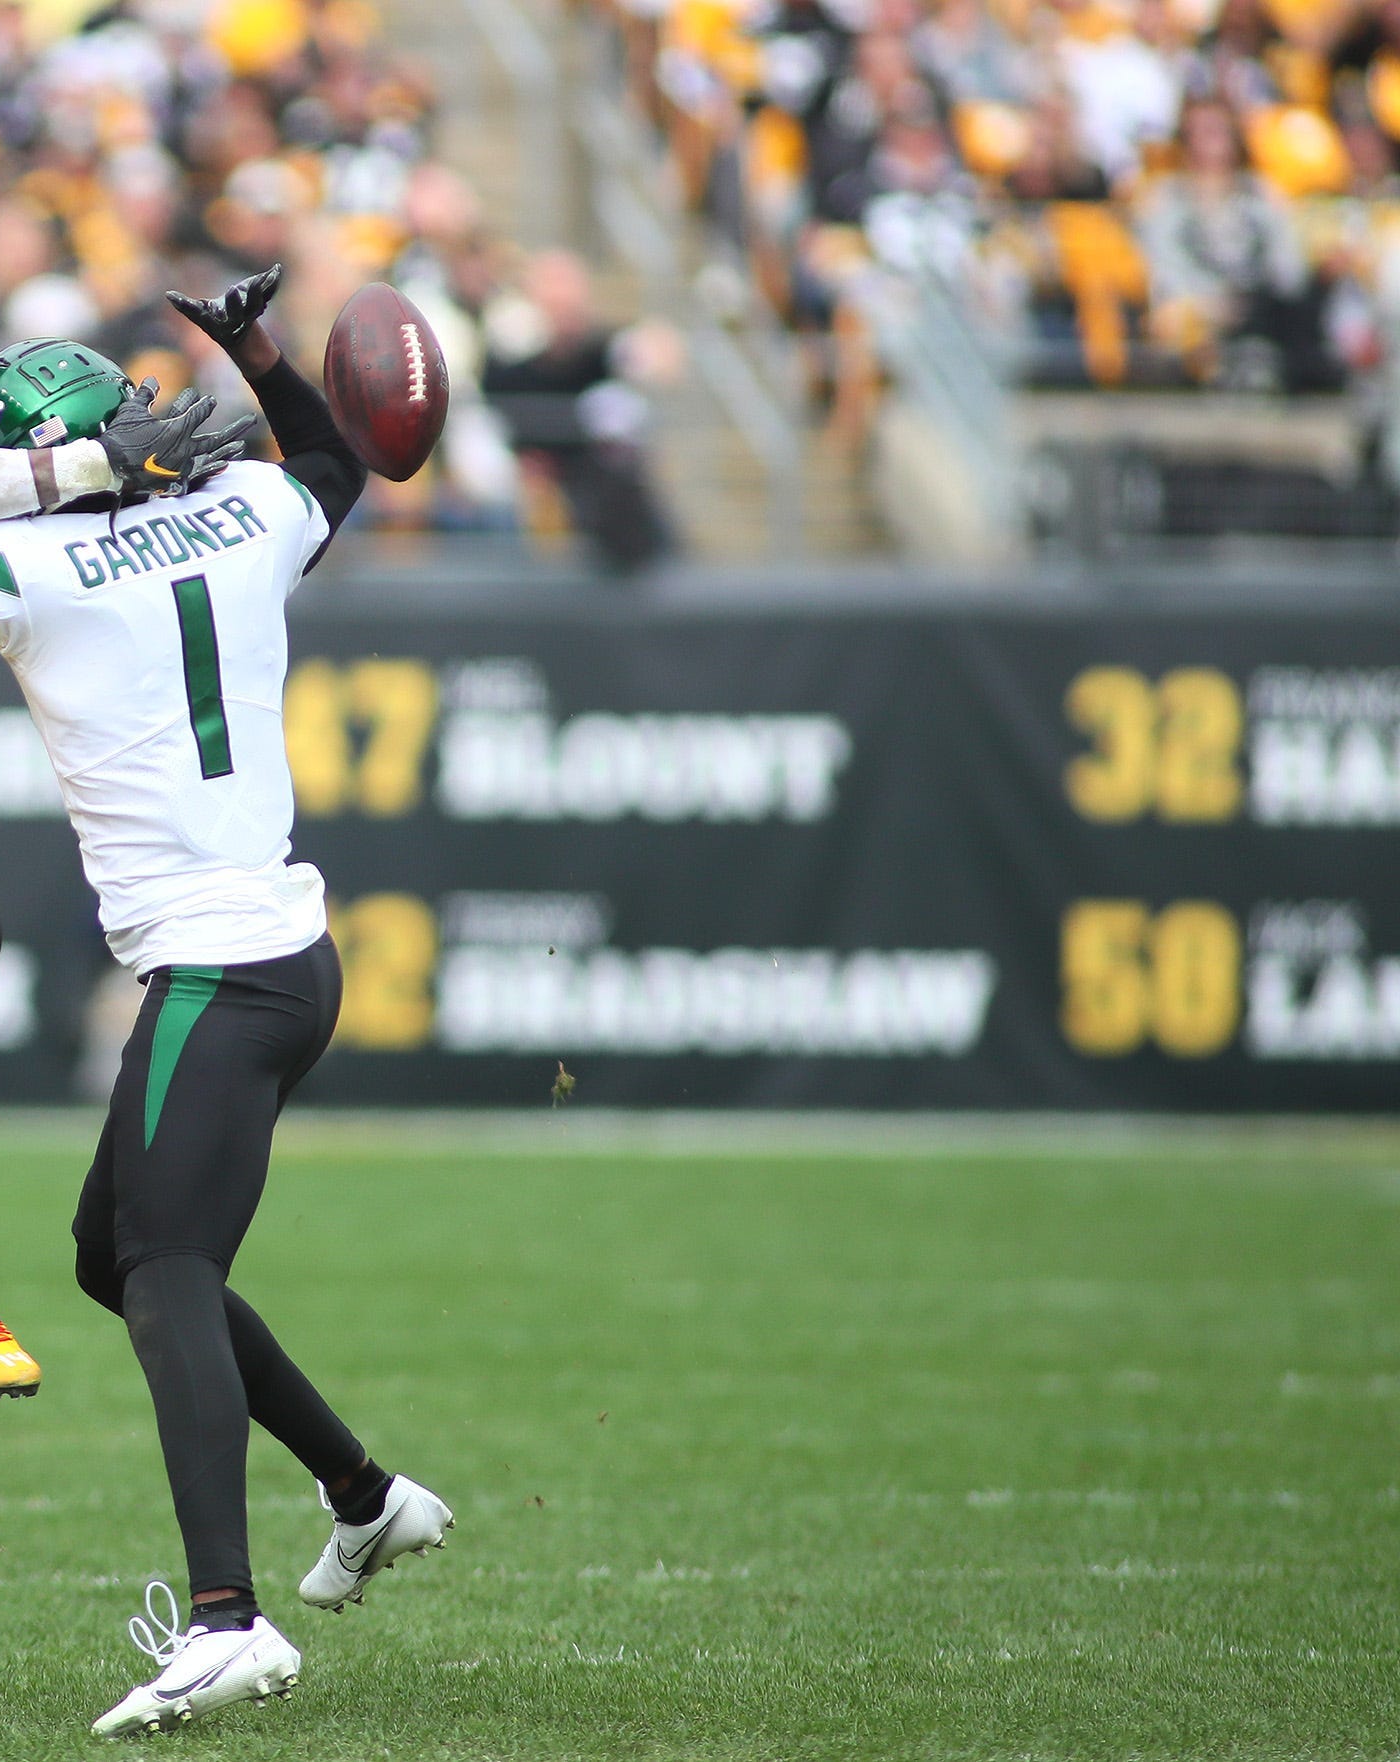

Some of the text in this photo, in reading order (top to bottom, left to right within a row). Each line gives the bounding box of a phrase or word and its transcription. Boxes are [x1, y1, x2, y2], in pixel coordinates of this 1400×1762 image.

[64, 495, 268, 589] GARDNER
[171, 573, 234, 780] 1
[438, 714, 852, 820] BLOUNT
[1066, 666, 1242, 824] 32
[438, 950, 992, 1054] BRADSHAW
